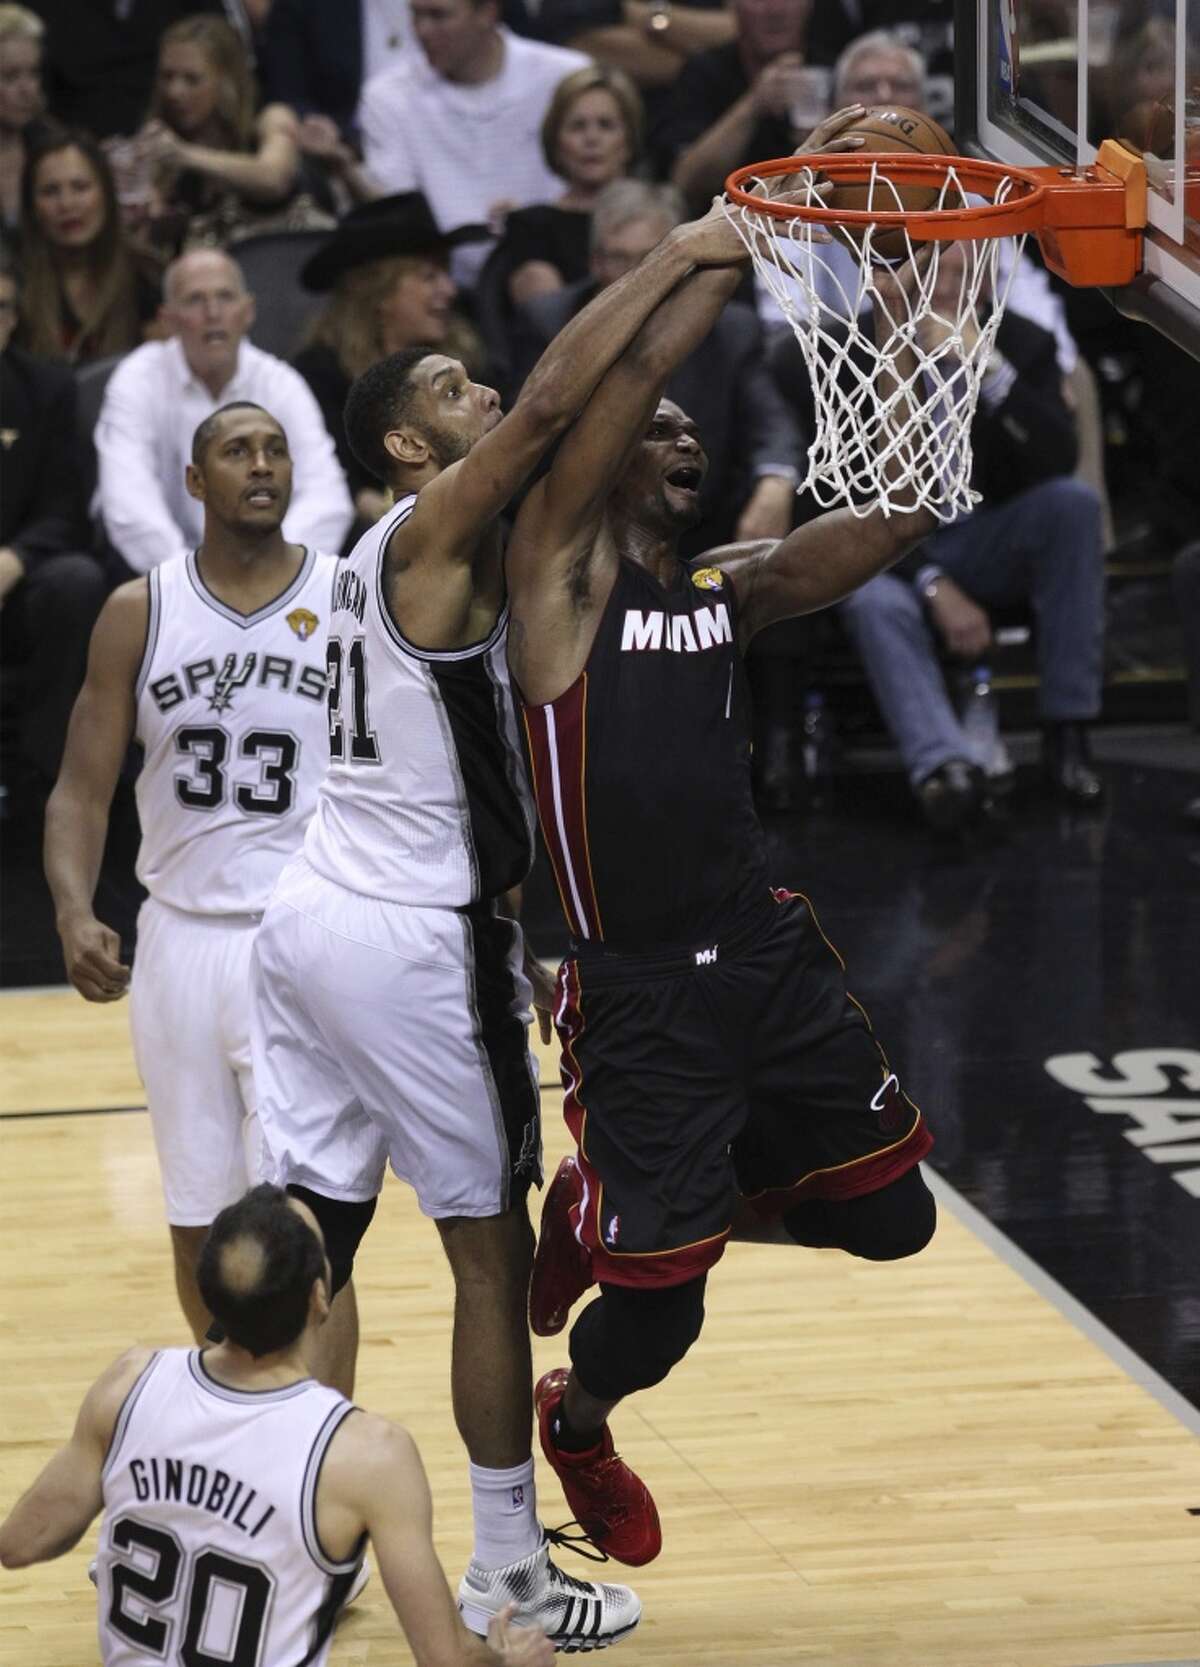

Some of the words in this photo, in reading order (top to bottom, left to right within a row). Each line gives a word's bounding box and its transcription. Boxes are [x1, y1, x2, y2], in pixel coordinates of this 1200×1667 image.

[620, 602, 734, 653] MIAM
[148, 652, 329, 716] SPURS
[327, 635, 383, 766] 21
[172, 724, 301, 819] 33
[1043, 1047, 1200, 1200] SA
[128, 1457, 277, 1539] GINOBILI
[105, 1511, 279, 1667] 20
